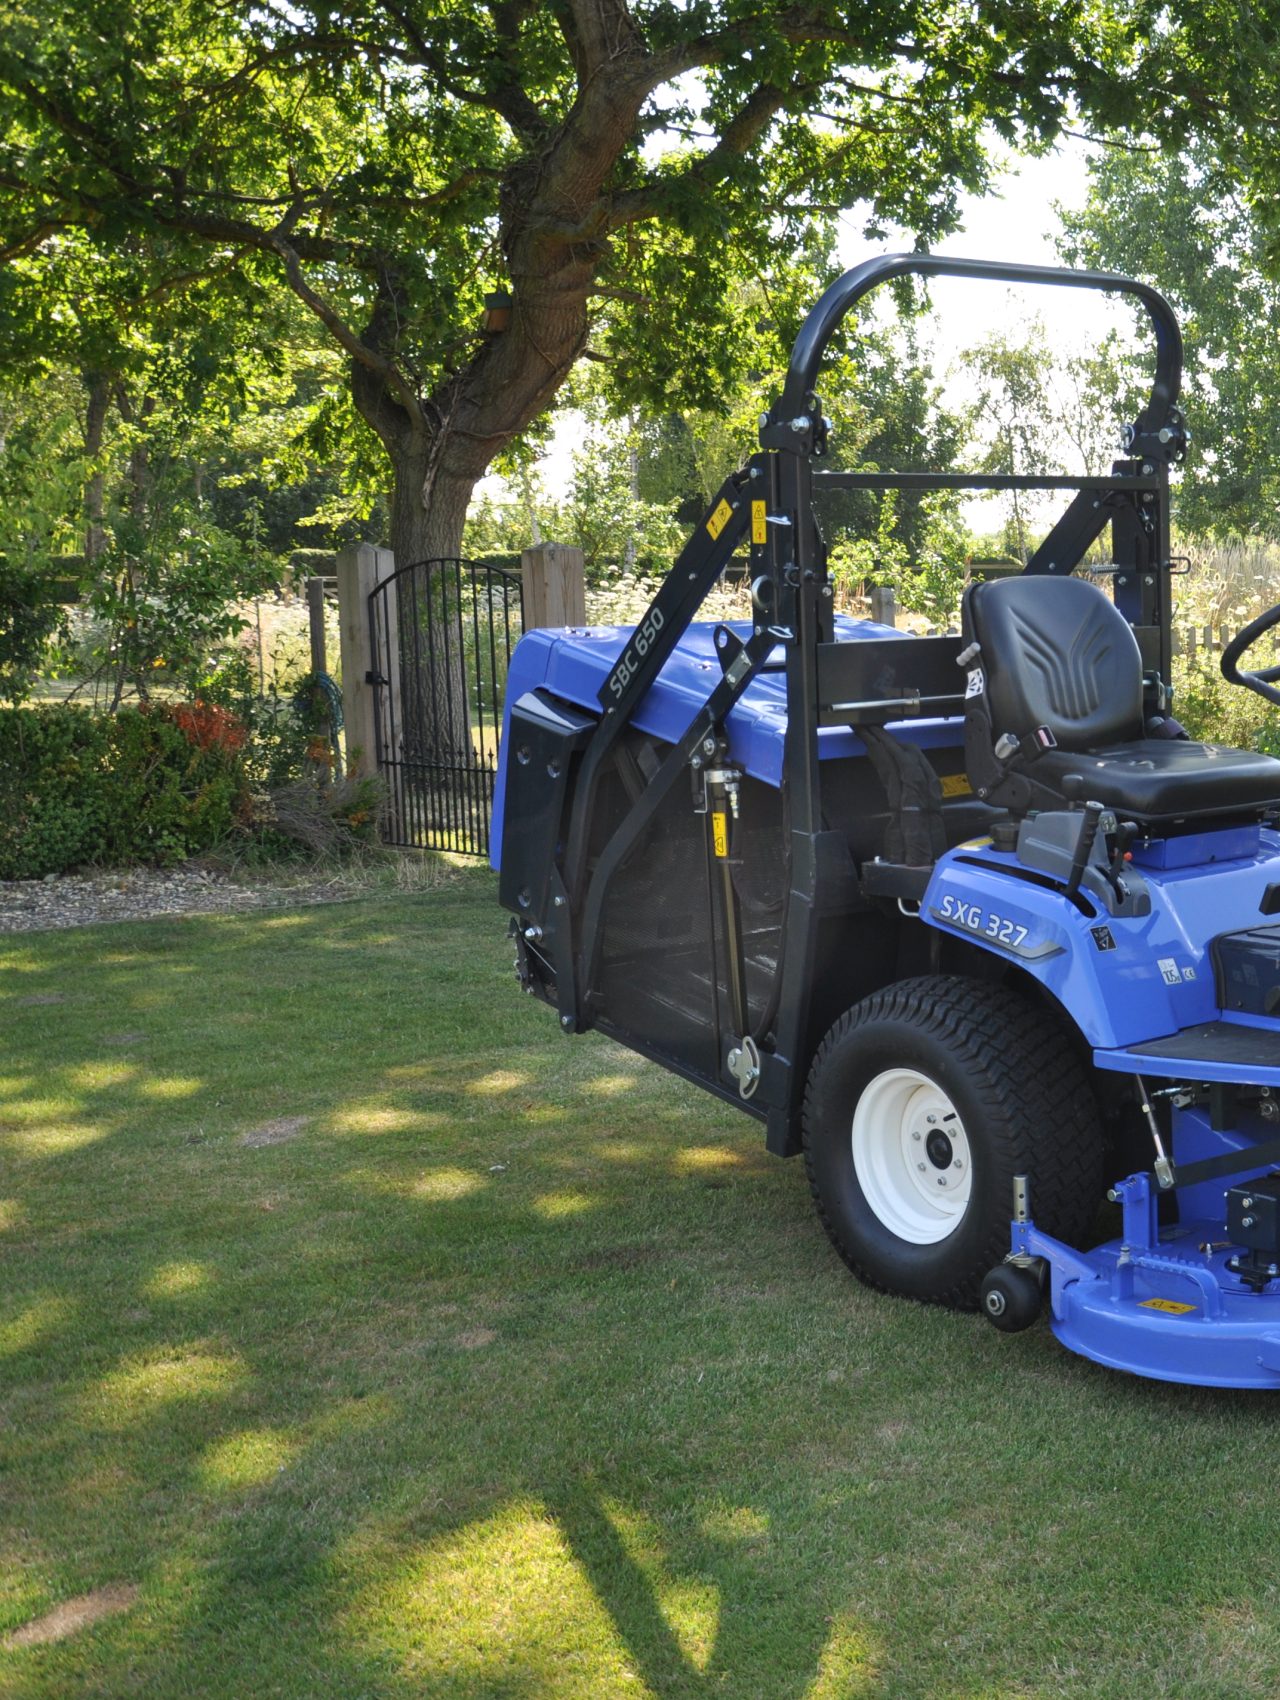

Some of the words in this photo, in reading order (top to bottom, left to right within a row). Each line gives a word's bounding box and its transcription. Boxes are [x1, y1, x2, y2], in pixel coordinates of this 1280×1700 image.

[609, 649, 639, 699] SBC
[634, 605, 665, 656] 650
[940, 895, 982, 929] SXG
[985, 914, 1028, 947] 327
